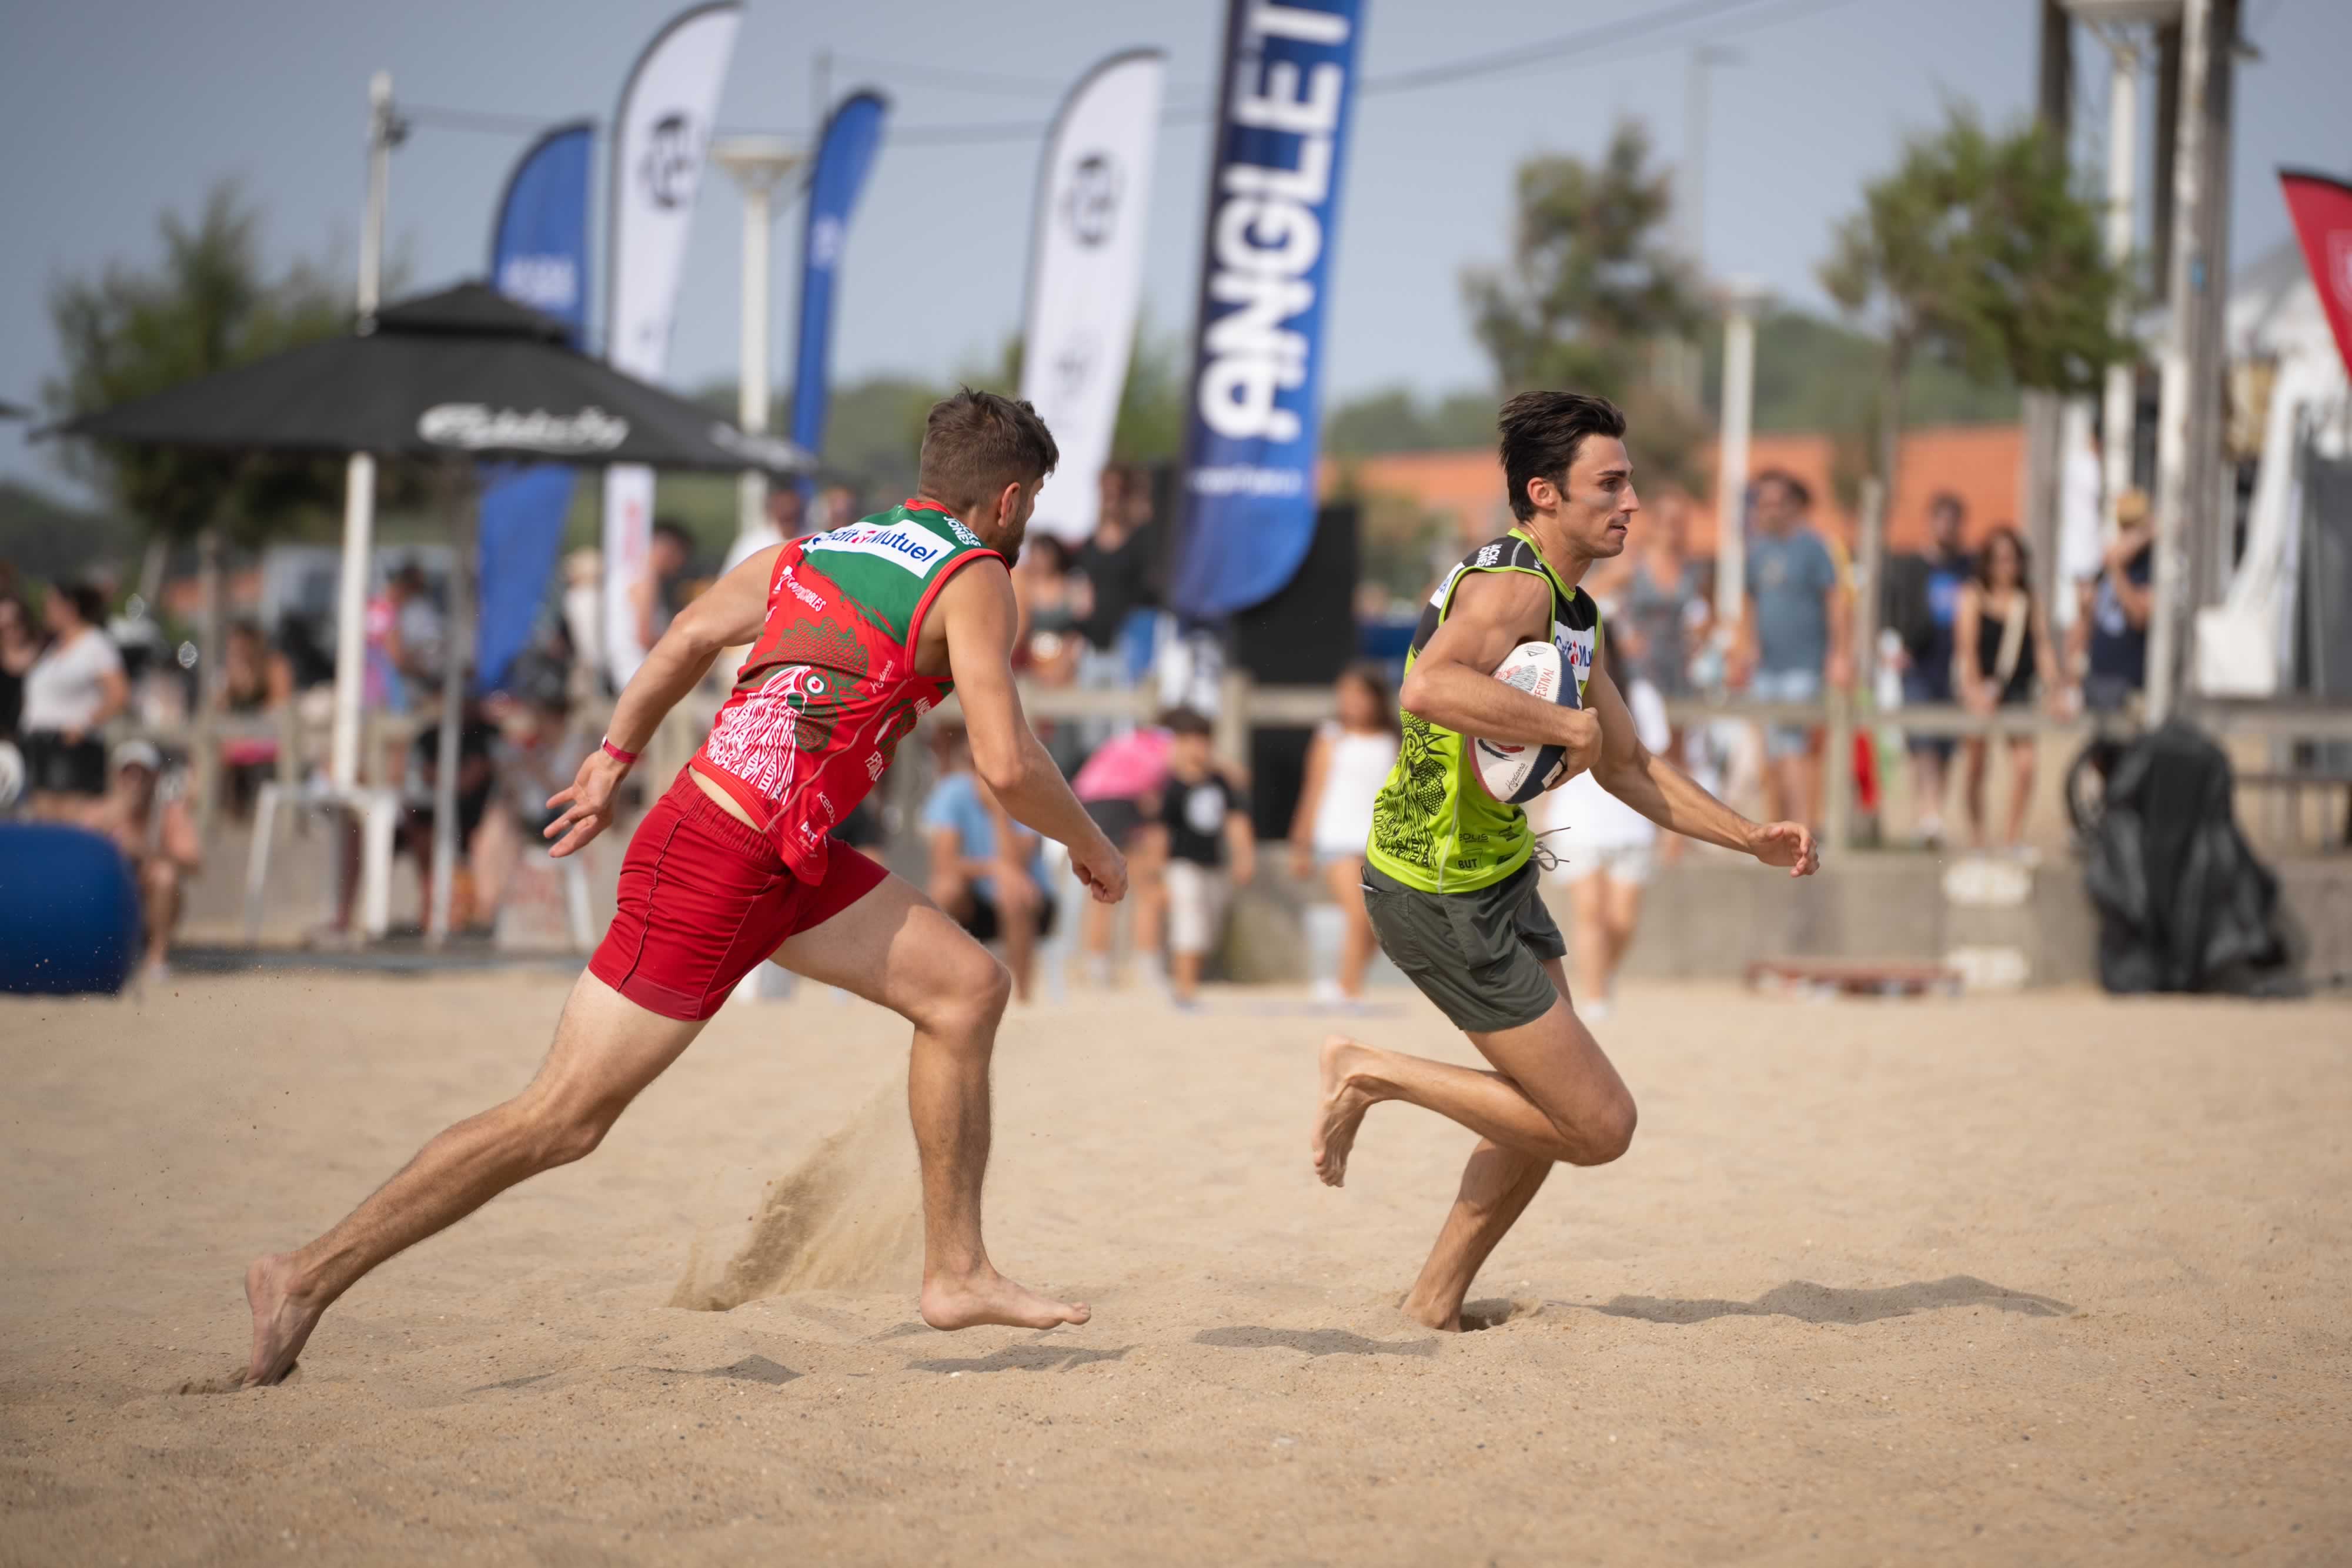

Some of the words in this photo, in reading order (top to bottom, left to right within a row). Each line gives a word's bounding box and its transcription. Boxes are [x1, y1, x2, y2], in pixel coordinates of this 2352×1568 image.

[866, 529, 938, 562] Mutuel
[1534, 668, 1555, 697] ESTIVAL
[1505, 762, 1526, 791] Hondarra
[1458, 859, 1478, 869] BUT
